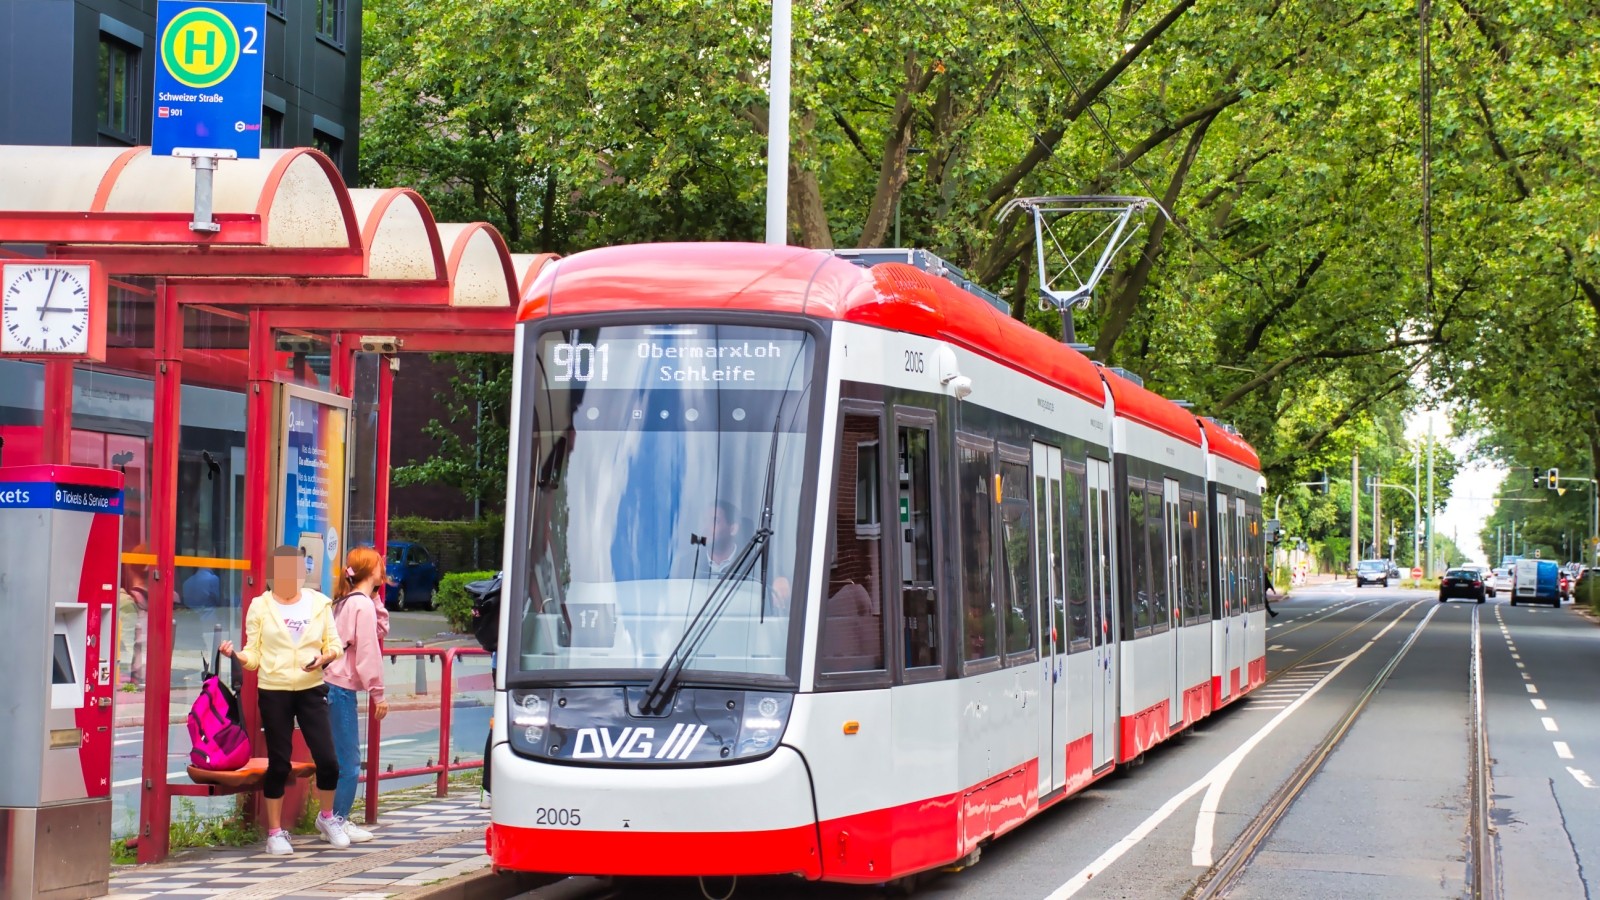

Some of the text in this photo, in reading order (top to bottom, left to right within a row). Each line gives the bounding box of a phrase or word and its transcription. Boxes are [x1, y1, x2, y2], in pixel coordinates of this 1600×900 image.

[185, 30, 216, 65] H
[242, 26, 258, 54] 2
[158, 92, 224, 103] Schweizer Straße
[170, 108, 183, 116] 901
[637, 342, 781, 358] Obermarxloh
[844, 344, 848, 357] 1
[553, 343, 609, 382] 901
[904, 350, 924, 374] 2005
[660, 366, 756, 381] Schleife
[63, 490, 82, 505] Tickets
[82, 494, 88, 505] &
[88, 493, 109, 508] Service
[579, 609, 599, 628] 17
[572, 727, 655, 758] DVG
[536, 807, 581, 826] 2005
